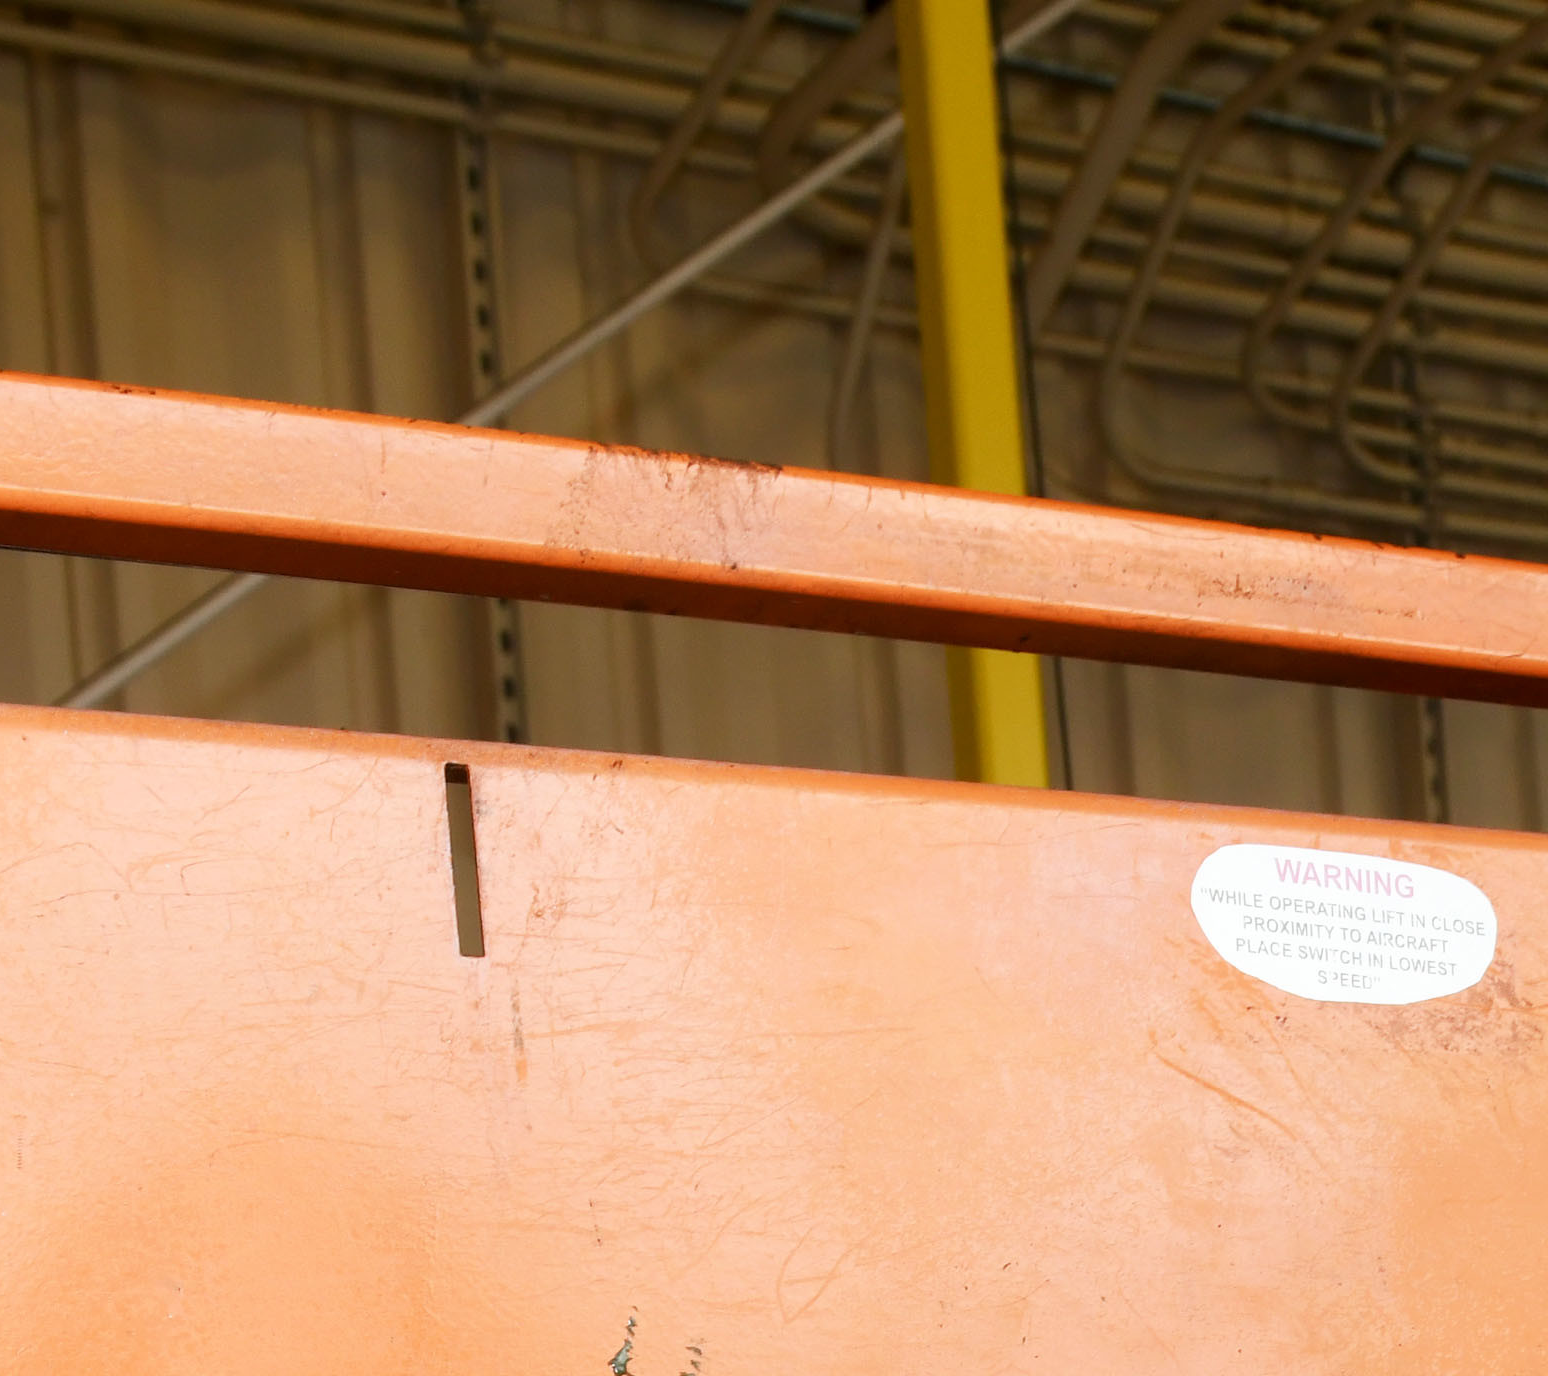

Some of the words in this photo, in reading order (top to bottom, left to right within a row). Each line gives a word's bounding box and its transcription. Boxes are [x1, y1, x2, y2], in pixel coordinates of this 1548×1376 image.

[1274, 857, 1415, 898] WARNING
[1200, 887, 1263, 909] "WHILE
[1269, 895, 1366, 921] OPERATING
[1371, 908, 1405, 926] LIFT
[1410, 913, 1425, 928] IN
[1431, 915, 1485, 936] CLOSE
[1243, 915, 1334, 939] PROXIMITY
[1339, 927, 1362, 943] TO
[1366, 930, 1448, 953] AIRCRAFT
[1235, 937, 1292, 958] PLACE
[1298, 945, 1362, 965] SWITCH
[1368, 952, 1383, 968] IN
[1389, 955, 1457, 976] LOWEST
